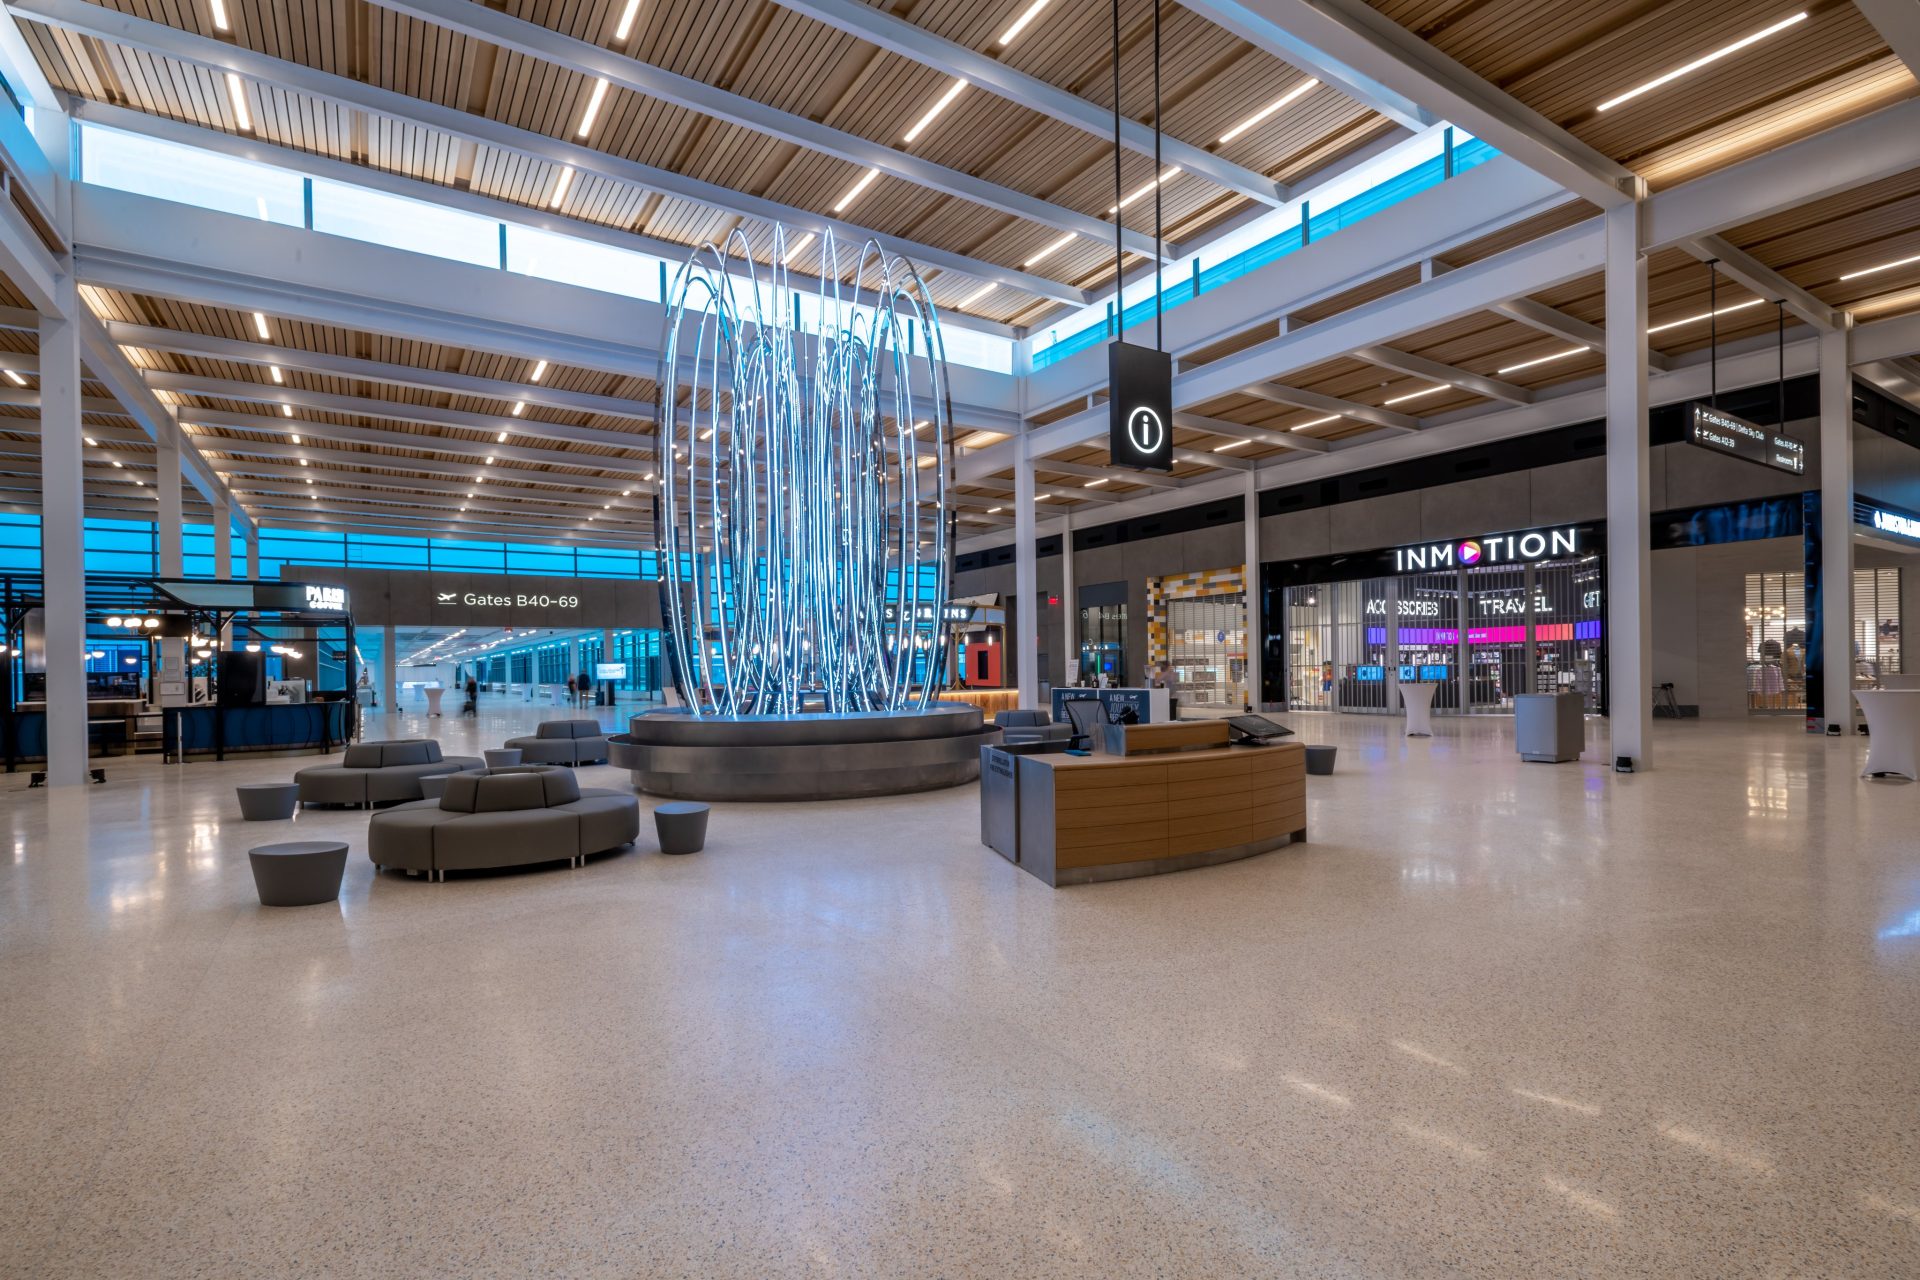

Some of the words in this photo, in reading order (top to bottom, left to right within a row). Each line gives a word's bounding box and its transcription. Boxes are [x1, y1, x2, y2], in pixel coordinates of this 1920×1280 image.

[464, 593, 512, 606] Gates
[517, 594, 578, 608] B40-69
[1366, 599, 1439, 616] ACCSSORIES
